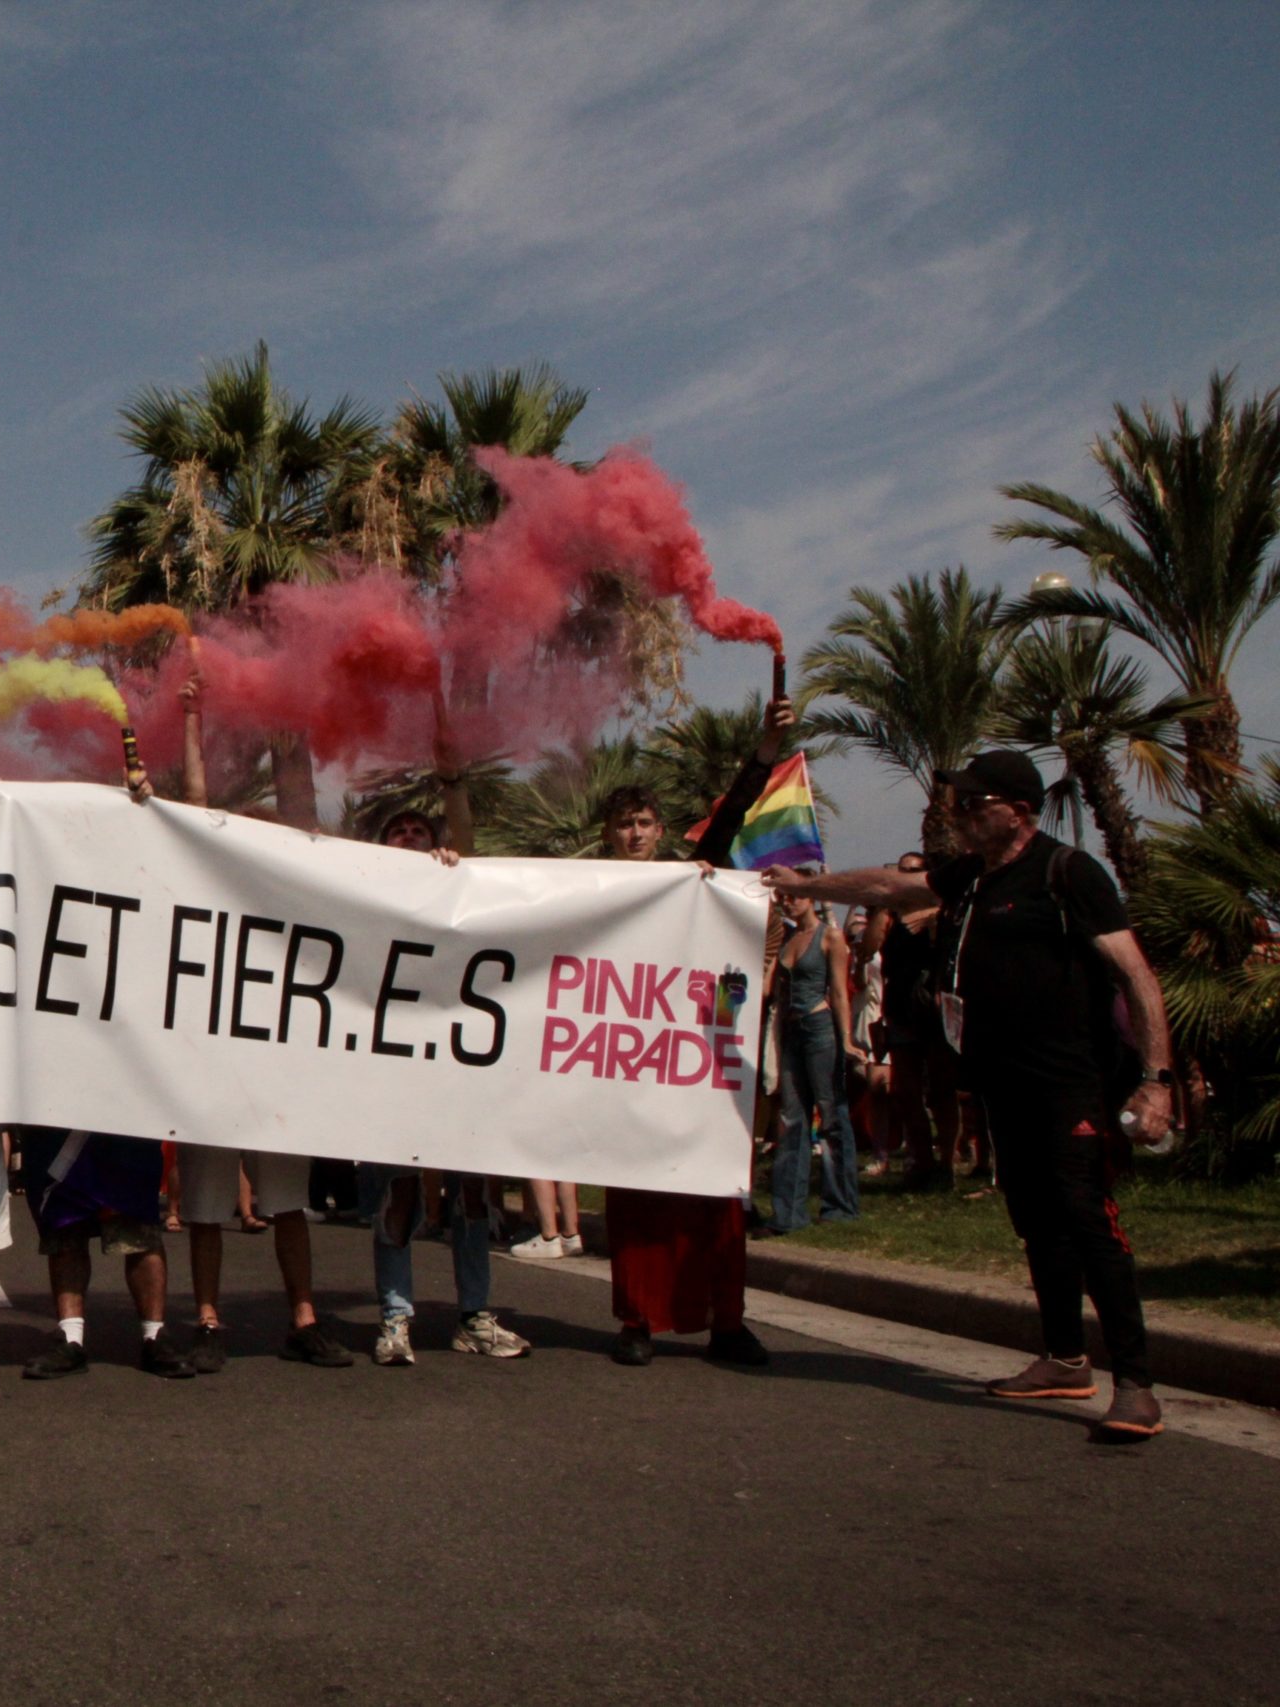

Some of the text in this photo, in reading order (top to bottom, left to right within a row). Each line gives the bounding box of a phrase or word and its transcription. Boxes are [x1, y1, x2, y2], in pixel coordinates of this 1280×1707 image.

[35, 884, 141, 1022] ET
[163, 905, 517, 1067] FIER.E.S
[546, 954, 683, 1024] PINK
[539, 1016, 744, 1092] PARADE
